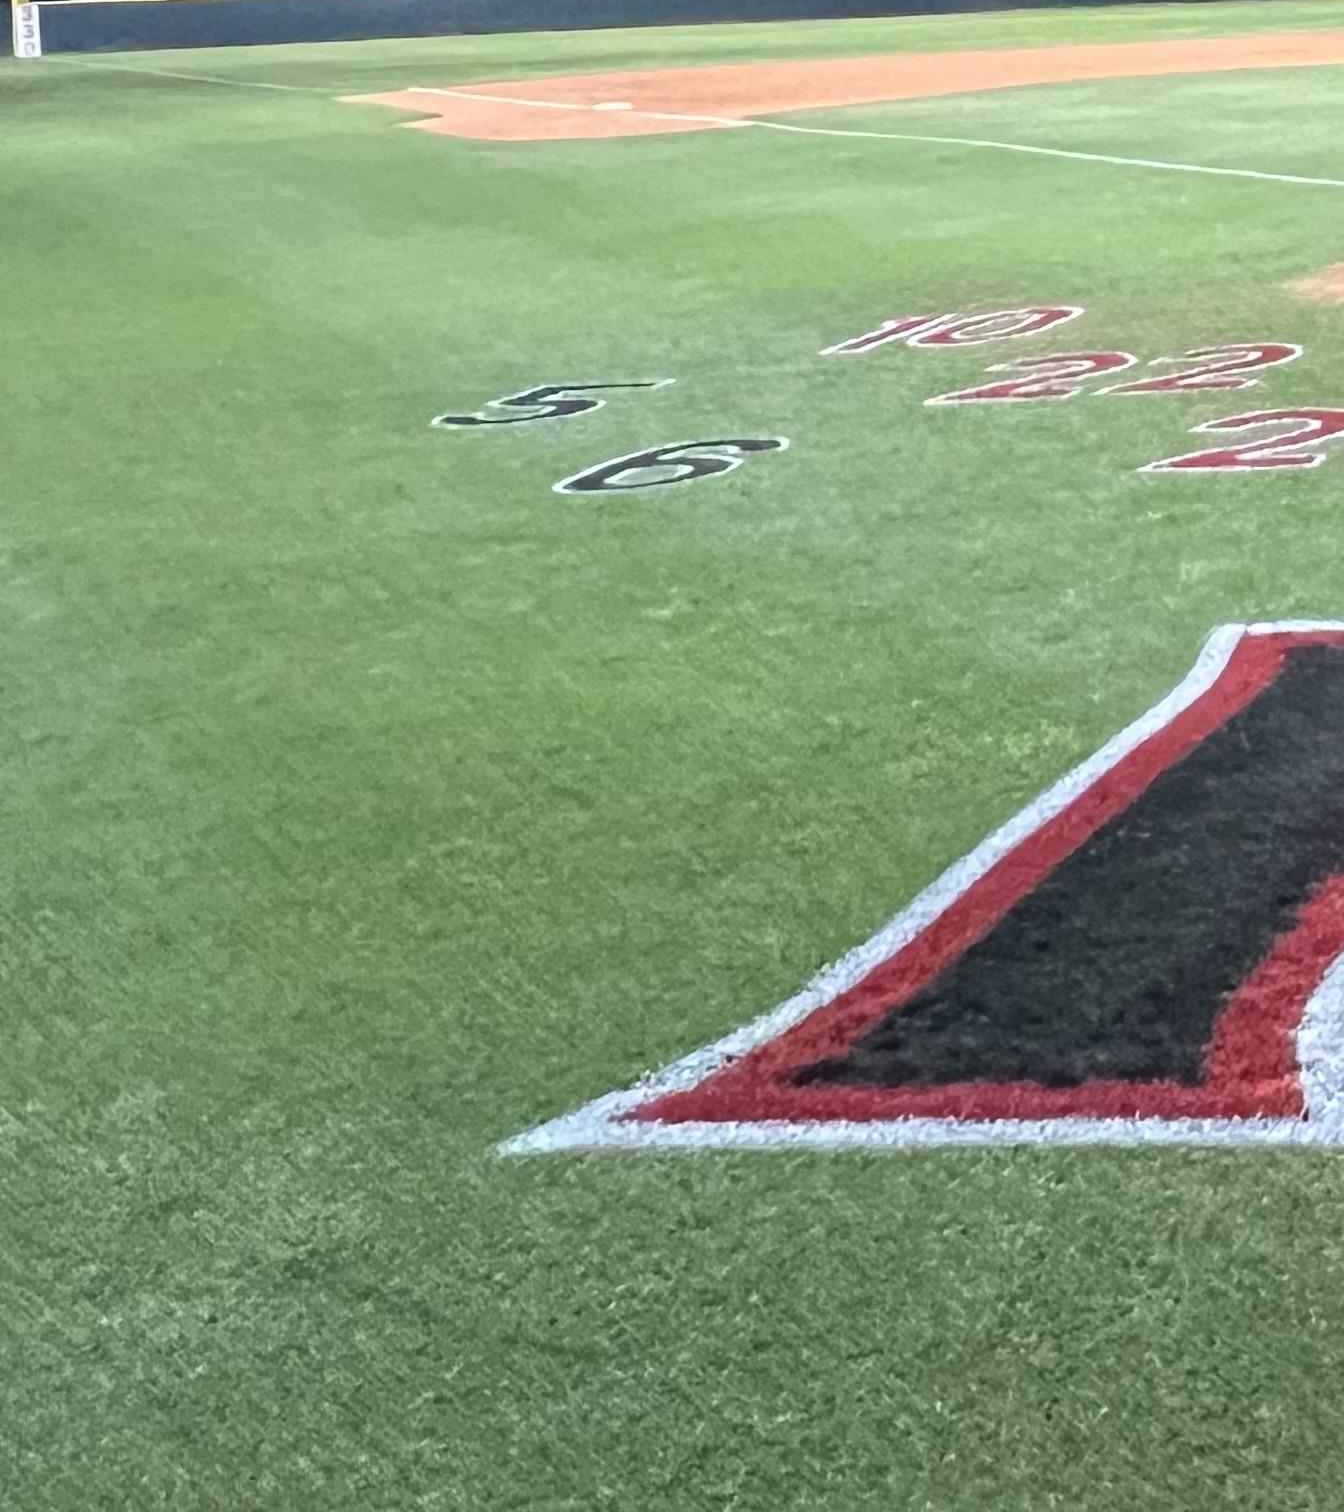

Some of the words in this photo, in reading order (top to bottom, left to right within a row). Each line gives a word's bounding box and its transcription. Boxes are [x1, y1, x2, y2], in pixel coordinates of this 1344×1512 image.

[818, 305, 1085, 354] 10
[922, 342, 1303, 406] 22
[430, 377, 676, 428] 5
[552, 436, 791, 494] 6
